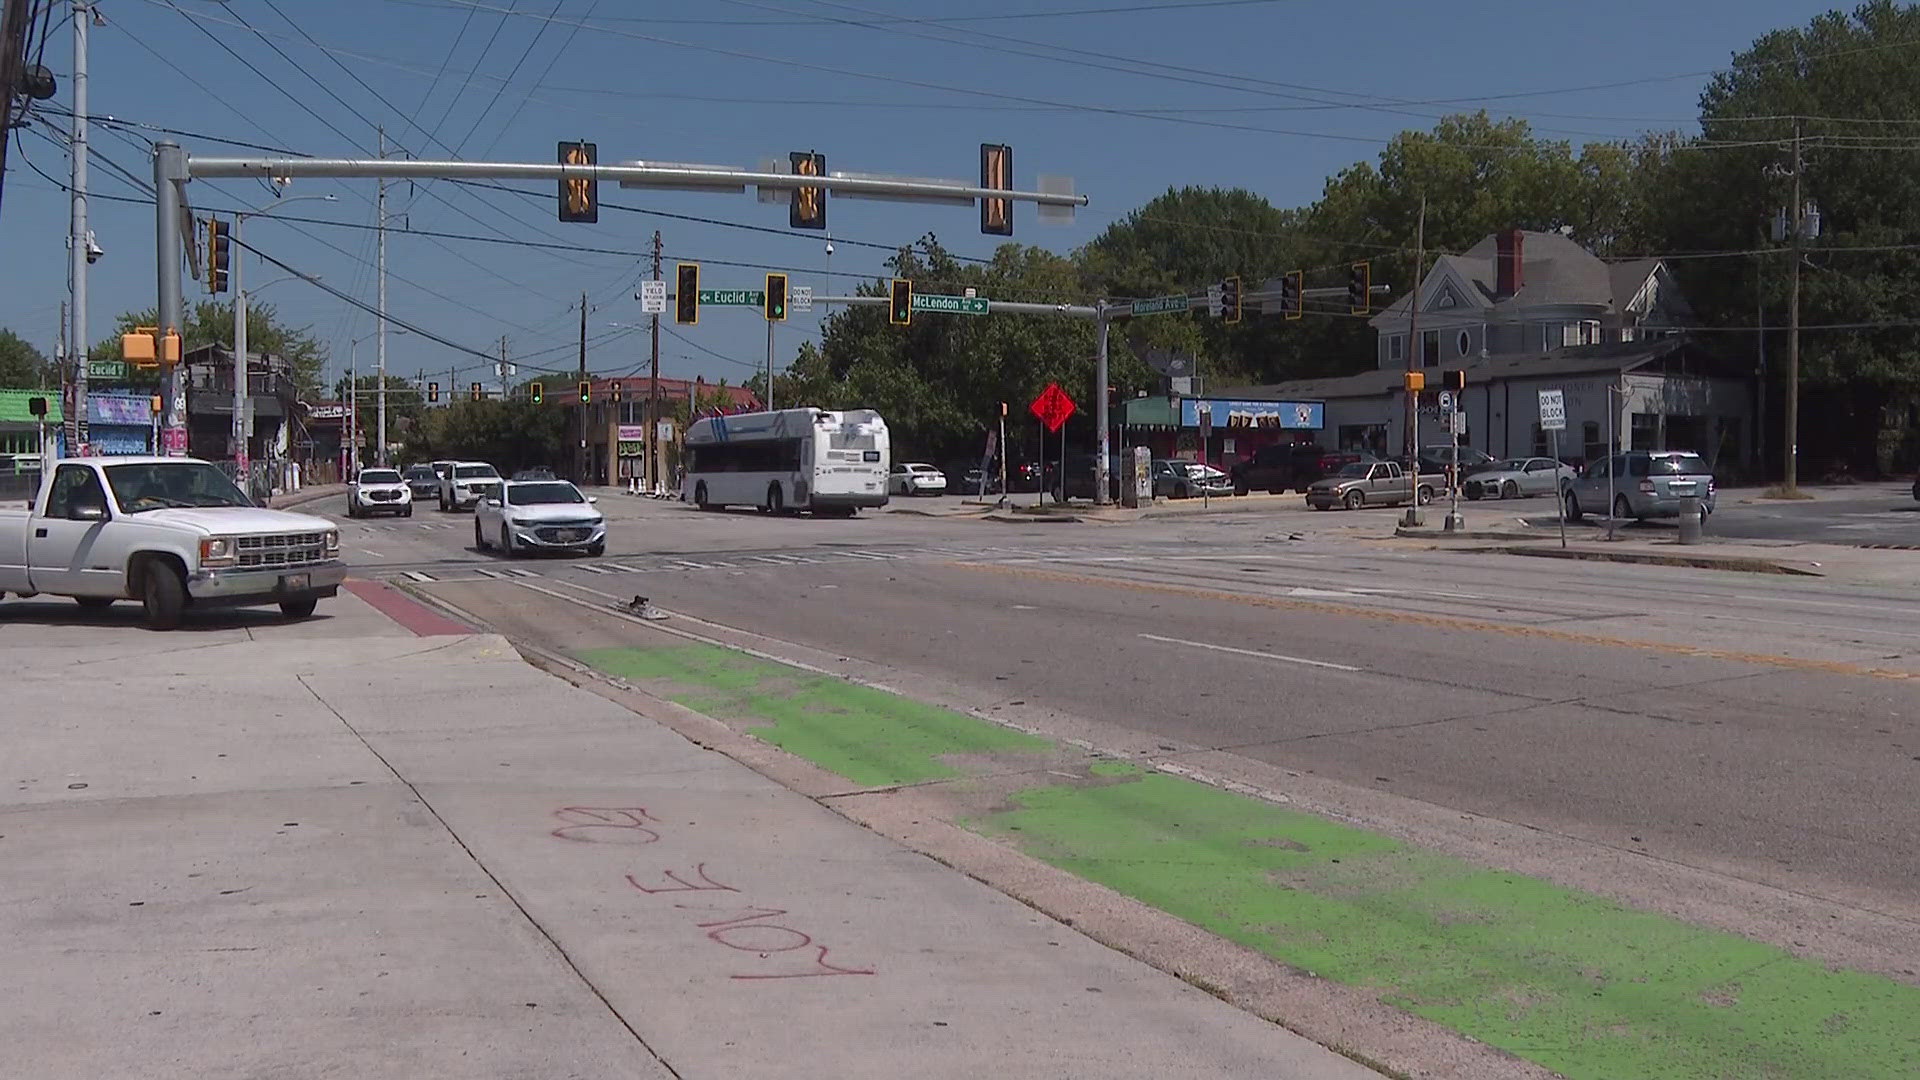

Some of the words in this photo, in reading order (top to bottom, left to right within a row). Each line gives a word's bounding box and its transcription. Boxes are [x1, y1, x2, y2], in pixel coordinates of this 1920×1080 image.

[714, 291, 746, 304] Euclid
[913, 296, 959, 310] McLendon
[90, 364, 117, 375] Euclid
[1540, 395, 1550, 406] DO
[1550, 395, 1562, 405] NOT
[1542, 407, 1564, 418] BLOCK
